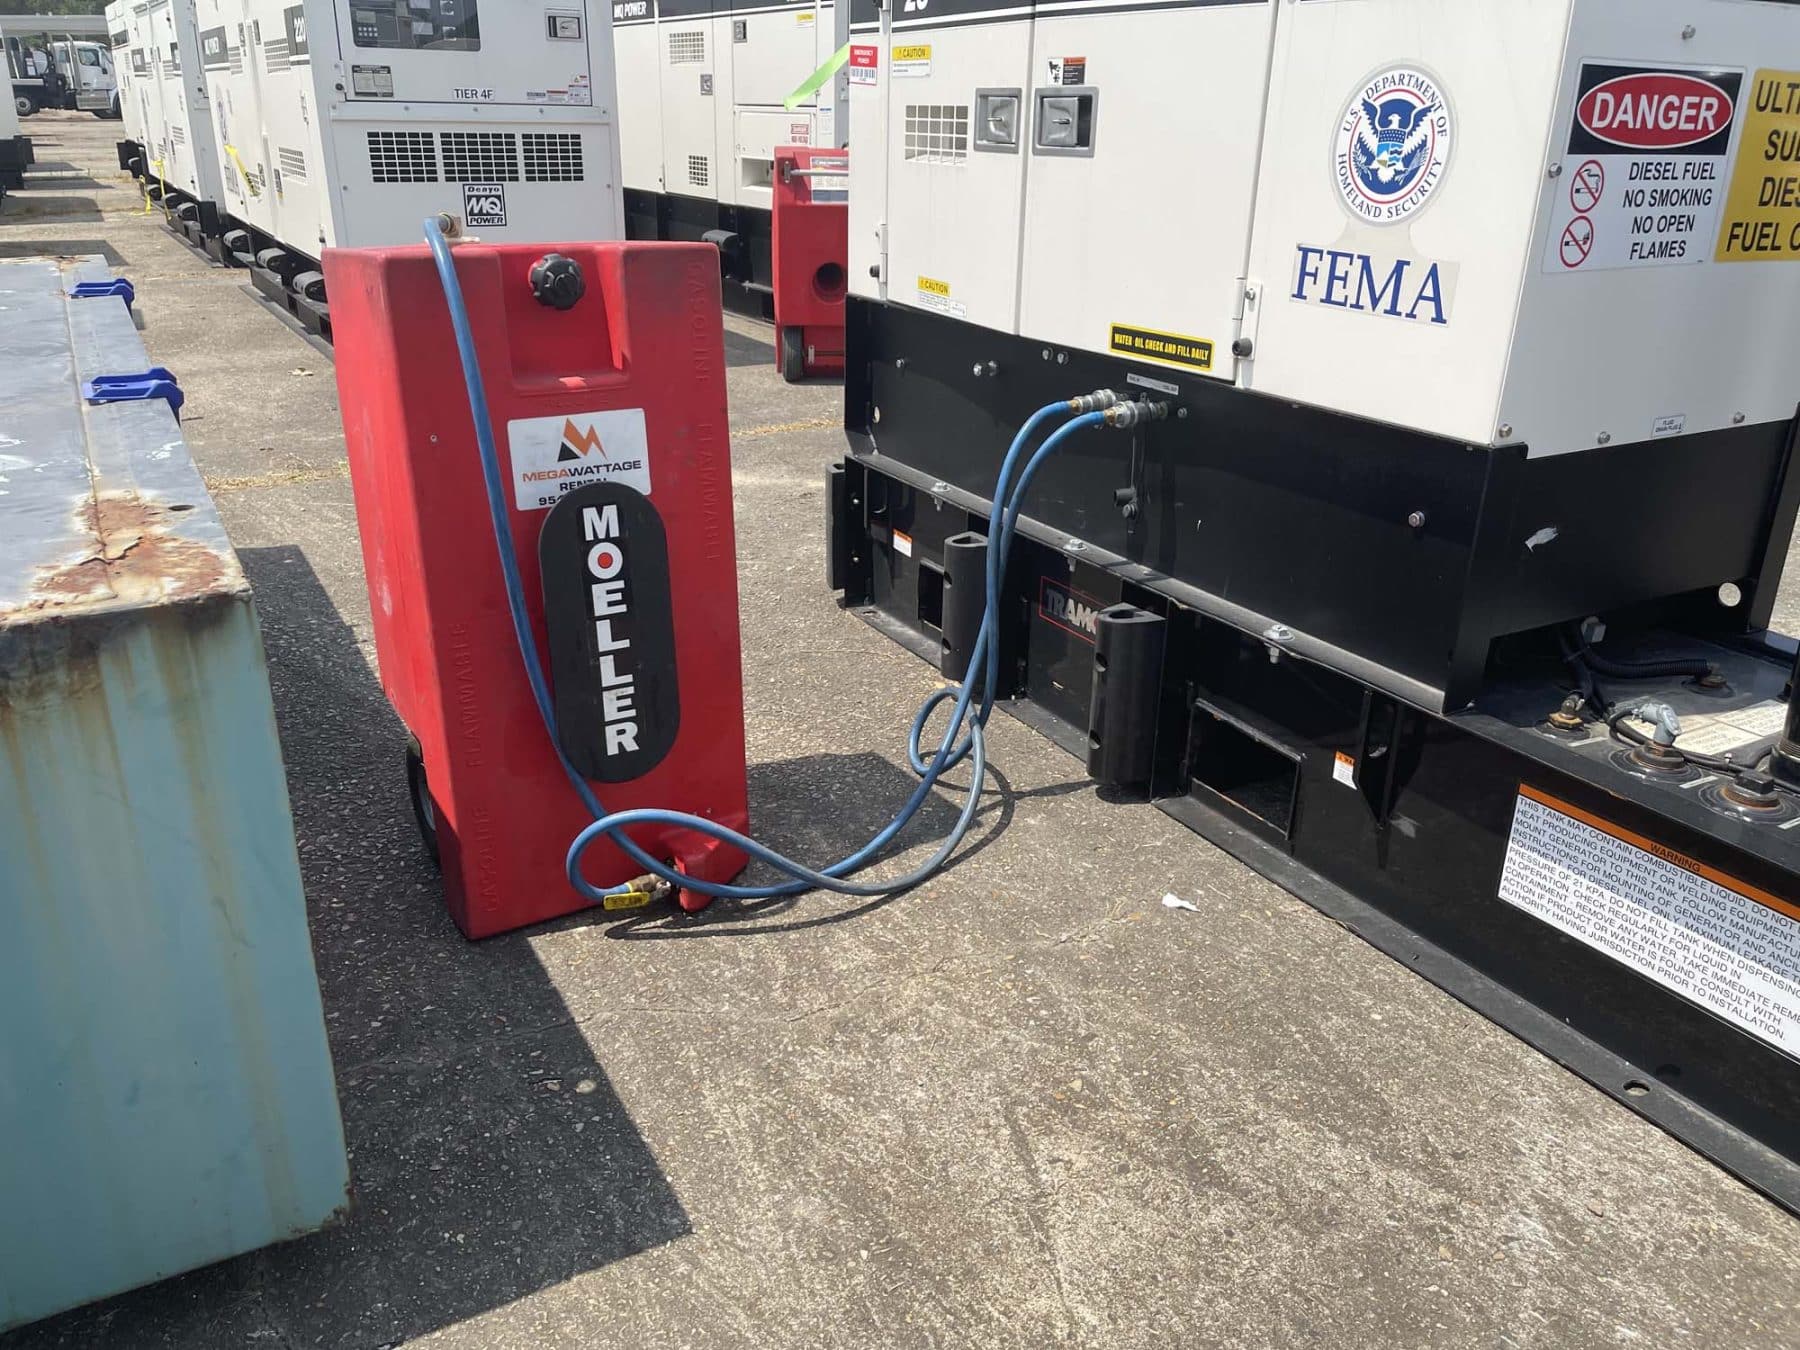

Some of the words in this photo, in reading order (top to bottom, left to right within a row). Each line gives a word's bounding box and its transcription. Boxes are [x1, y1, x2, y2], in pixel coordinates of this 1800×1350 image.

[624, 1, 647, 16] POWER
[902, 48, 926, 58] CAUTION
[454, 89, 478, 99] TIER
[480, 89, 493, 99] 4F
[1343, 108, 1361, 132] U.S.
[1364, 73, 1444, 113] DEPARTMENT
[1437, 116, 1448, 137] OF
[1591, 92, 1719, 130] DANGER
[1755, 79, 1800, 114] ULT
[1338, 153, 1382, 218] HOMELAND
[1387, 157, 1442, 219] SECURITY
[1629, 162, 1679, 181] DIESEL
[1682, 162, 1716, 181] FUEL
[467, 196, 503, 215] MQ
[1622, 189, 1645, 208] NO
[1648, 188, 1713, 208] SMOKING
[470, 216, 503, 224] POWER
[1631, 215, 1654, 234] NO
[1656, 214, 1696, 233] OPEN
[1726, 222, 1782, 252] FUEL
[1629, 239, 1687, 260] FLAMES
[925, 280, 949, 294] CAUTION
[1291, 245, 1447, 324] FEMA
[1114, 333, 1133, 346] WATER
[1134, 336, 1144, 348] OIL
[1145, 339, 1164, 353] CHECK
[1164, 342, 1177, 354] AND
[1177, 344, 1190, 357] FILL
[1191, 347, 1209, 360] DAILY
[522, 460, 641, 482] MEGAWATTAGE
[582, 504, 640, 756] MOELLER
[1514, 817, 1545, 836] MOUNT
[1549, 833, 1606, 865] GENERATOR
[1610, 862, 1622, 873] TO
[1625, 869, 1646, 885] THIS
[1682, 896, 1726, 922] FOLLOW
[1517, 807, 1539, 822] HEAT
[1542, 819, 1597, 849] PRODUCING
[1600, 845, 1656, 876] EQUIPMENT
[1660, 873, 1675, 885] OR
[1679, 882, 1726, 909] WELDING
[1729, 905, 1795, 942] EQUIPMENT
[1520, 798, 1539, 810] THIS
[1542, 808, 1565, 823] TANK
[1568, 820, 1587, 833] MAY
[1589, 829, 1632, 854] CONTAIN
[1635, 850, 1706, 888] COMBUSTIBLE
[1751, 903, 1768, 917] DO
[1772, 912, 1794, 929] NOT
[1650, 843, 1701, 872] WARNING
[1509, 846, 1556, 874] PRESSURE
[1558, 871, 1570, 881] OF
[1573, 878, 1582, 887] 21
[1610, 896, 1623, 909] DO
[1627, 905, 1646, 920] NOT
[1649, 916, 1668, 930] FILL
[1673, 927, 1699, 946] TANK
[1703, 942, 1734, 964] WHEN
[1513, 827, 1578, 863] INSTRUCTIONS
[1581, 860, 1600, 874] FOR
[1603, 870, 1654, 899] MOUNTING
[1657, 896, 1672, 908] OF
[1675, 904, 1740, 942] GENERATOR
[1743, 937, 1765, 955] AND
[1507, 856, 1515, 864] IN
[1573, 889, 1605, 911] CHECK
[1608, 907, 1666, 941] REGULARLY
[1669, 938, 1690, 953] FOR
[1693, 950, 1727, 973] LIQUID
[1731, 969, 1741, 980] IN
[1567, 863, 1586, 878] FOR
[1588, 874, 1621, 895] DIESEL
[1624, 891, 1648, 909] FUEL
[1685, 921, 1734, 951] MAXIMUM
[1737, 947, 1791, 980] LEAKAGE
[1501, 884, 1550, 914] AUTHORITY
[1553, 912, 1586, 934] HAVING
[1588, 930, 1654, 970] JURISDICTION
[1657, 967, 1688, 988] PRIOR
[1692, 986, 1705, 997] TO
[1708, 995, 1785, 1041] INSTALLATION.
[1503, 874, 1534, 896] ACTION
[1537, 892, 1544, 901] IF
[1547, 898, 1591, 926] PRODUCT
[1593, 922, 1607, 934] OR
[1610, 931, 1644, 955] WATER
[1647, 950, 1656, 960] IS
[1701, 978, 1750, 1010] CONSULT
[1754, 1006, 1781, 1027] WITH
[1576, 902, 1615, 927] REMOVE
[1617, 923, 1637, 939] ANY
[1682, 956, 1709, 976] TAKE
[1711, 972, 1770, 1009] IMMEDIATE
